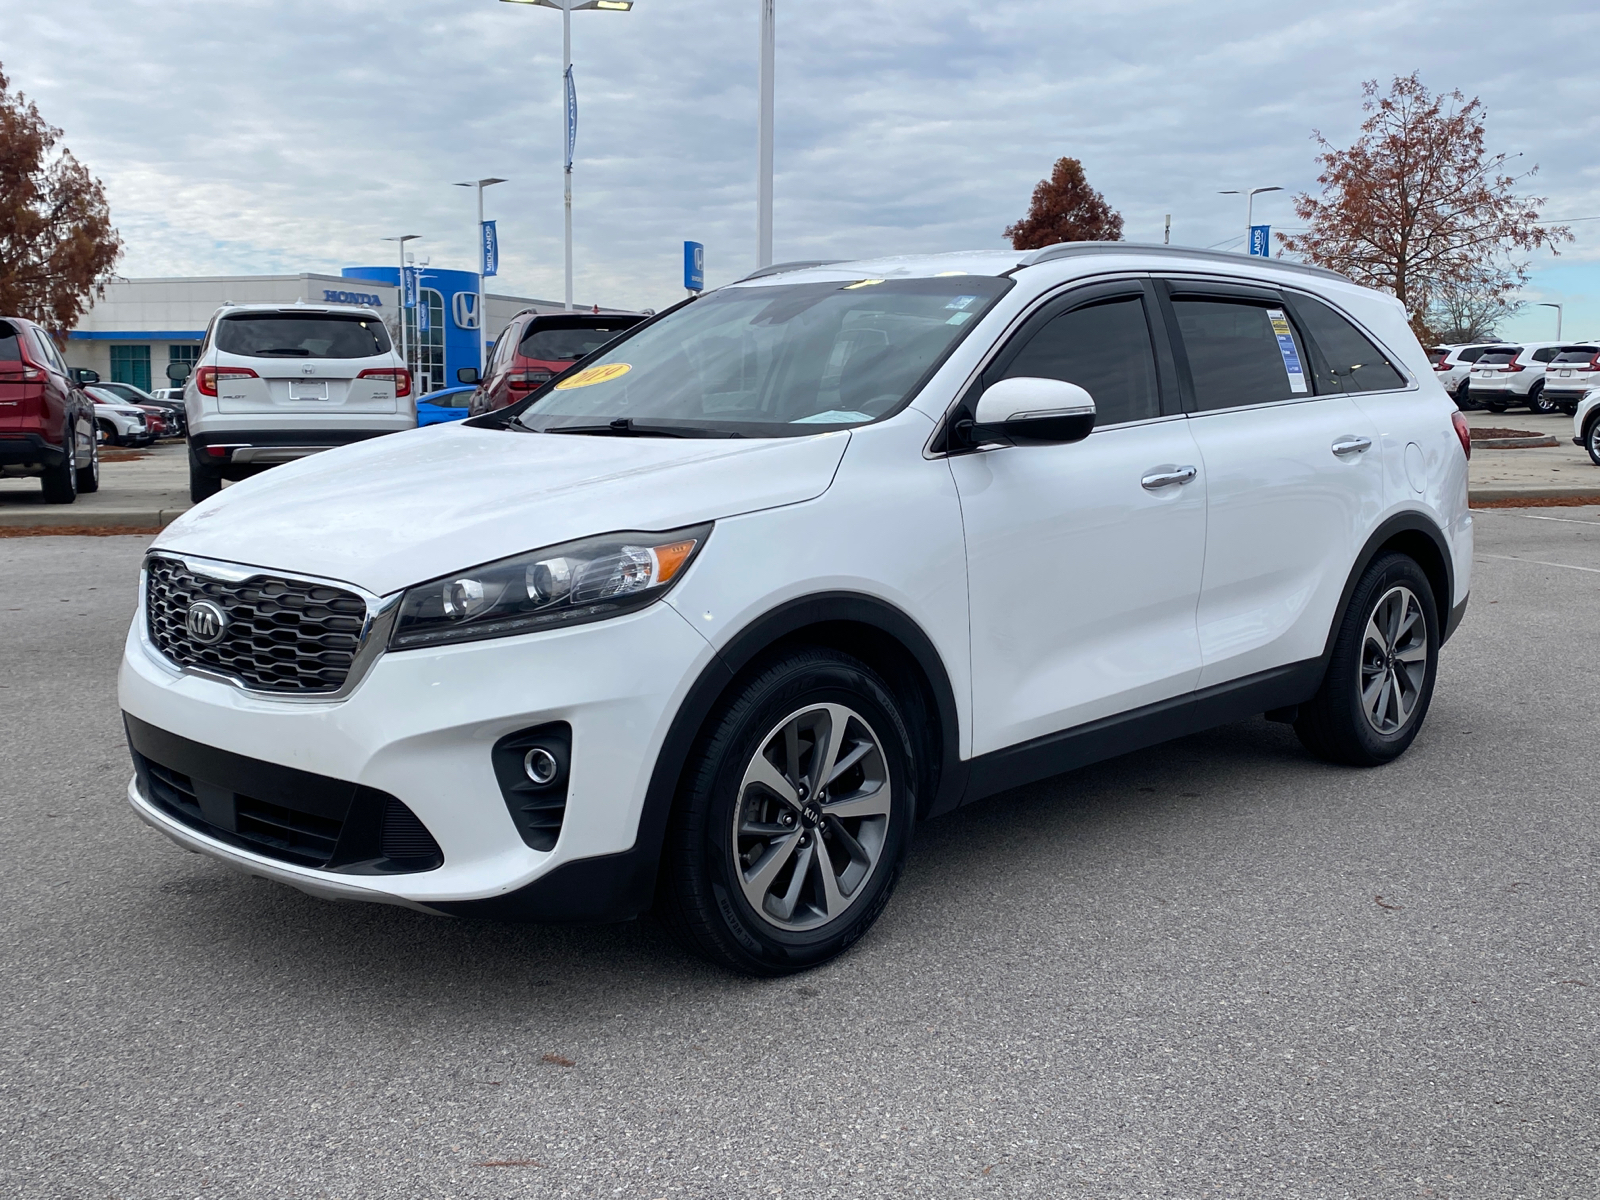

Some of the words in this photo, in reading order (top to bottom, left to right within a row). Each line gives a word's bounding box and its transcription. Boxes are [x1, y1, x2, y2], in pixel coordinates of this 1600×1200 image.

[322, 289, 383, 306] HONDA
[561, 365, 624, 386] 2019
[189, 609, 215, 636] KIA
[804, 807, 818, 824] KIA
[720, 898, 743, 936] WEATHER
[742, 934, 755, 947] ALL
